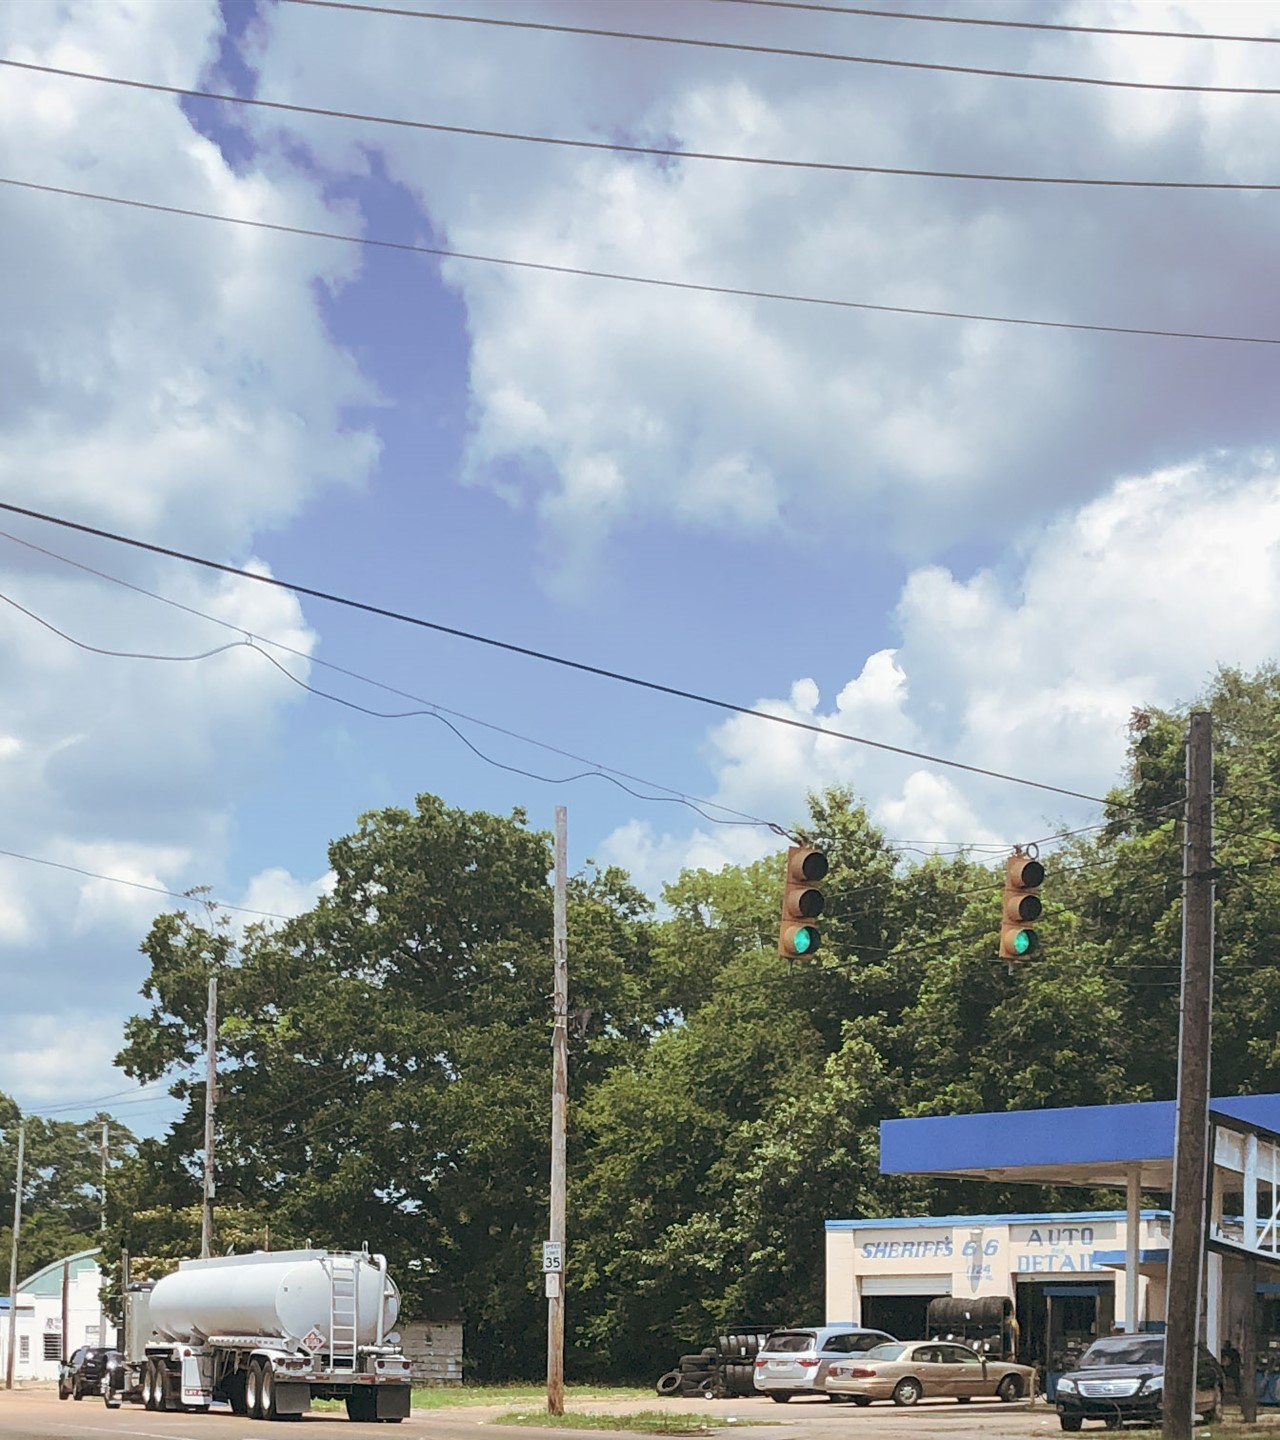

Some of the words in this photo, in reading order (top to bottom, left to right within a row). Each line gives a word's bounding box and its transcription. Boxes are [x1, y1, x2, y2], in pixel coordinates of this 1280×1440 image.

[1026, 1227, 1094, 1247] AUTO
[545, 1256, 561, 1268] 35
[1017, 1253, 1103, 1272] DETAIL
